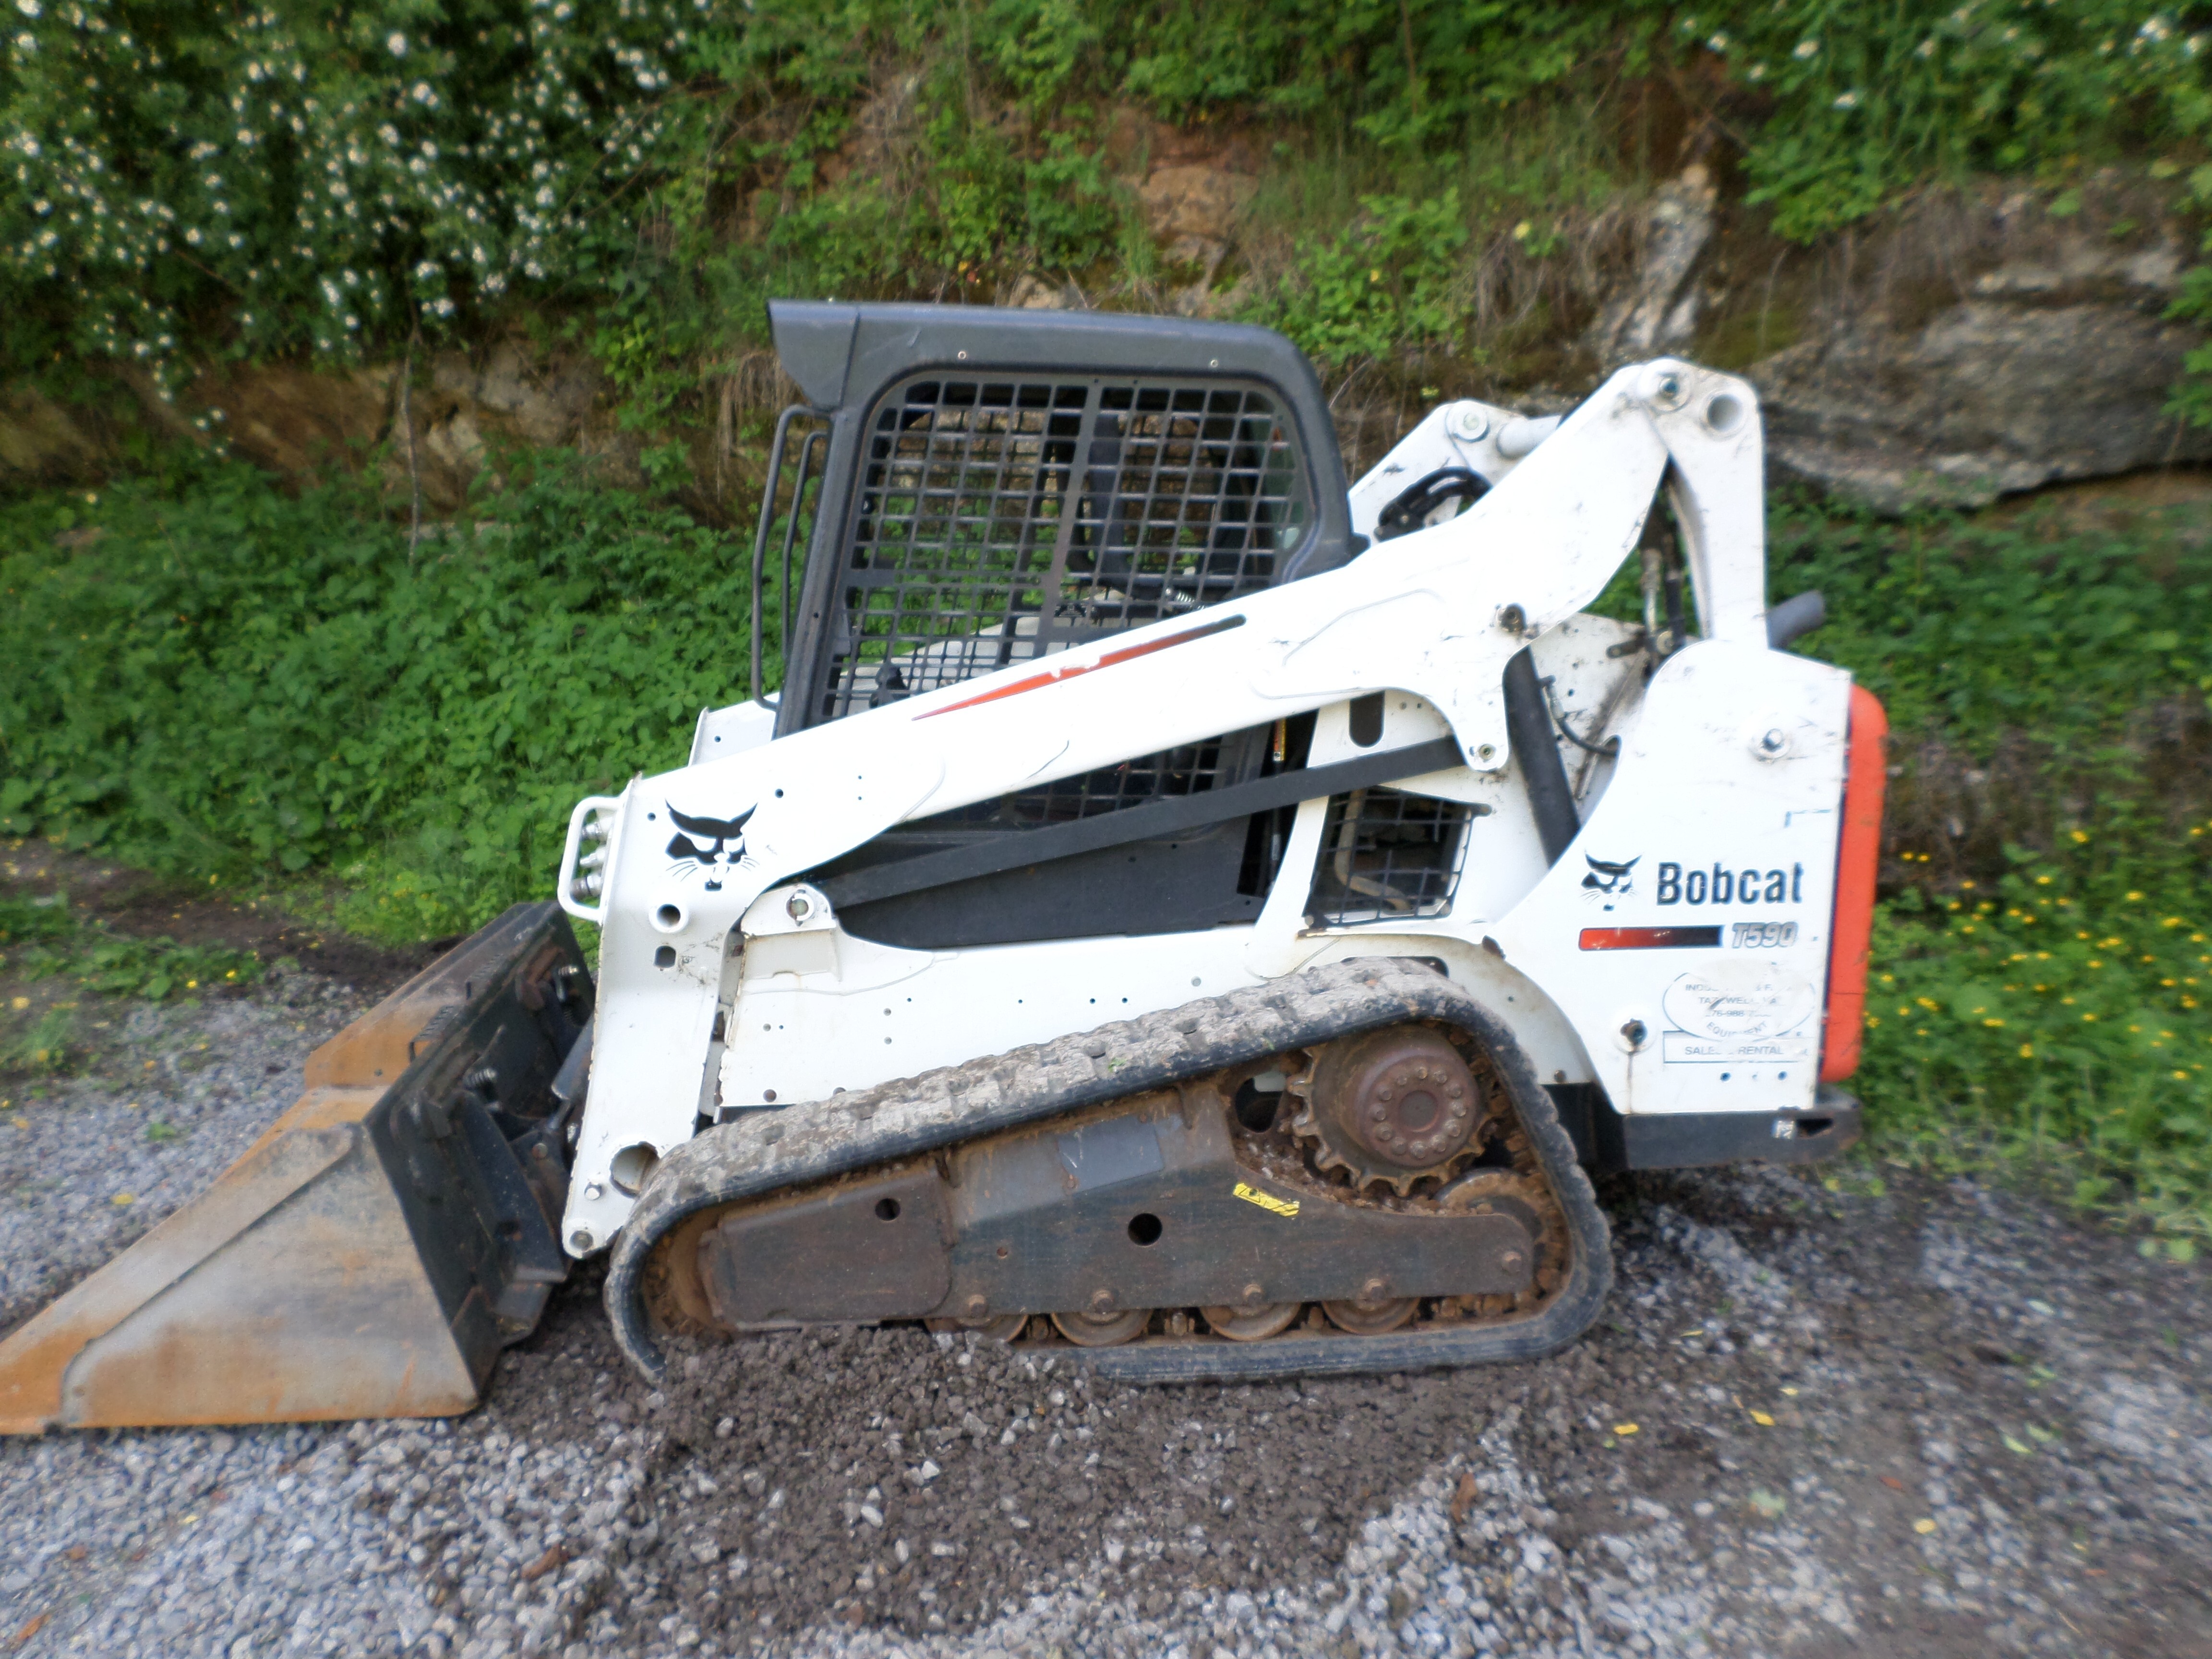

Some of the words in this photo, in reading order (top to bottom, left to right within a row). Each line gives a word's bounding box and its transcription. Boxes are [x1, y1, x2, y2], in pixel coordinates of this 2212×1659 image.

[1656, 861, 1803, 906] Bobcat
[1731, 921, 1799, 949] T590
[1684, 1046, 1721, 1055] SALE
[1738, 1046, 1785, 1055] RENTAL
